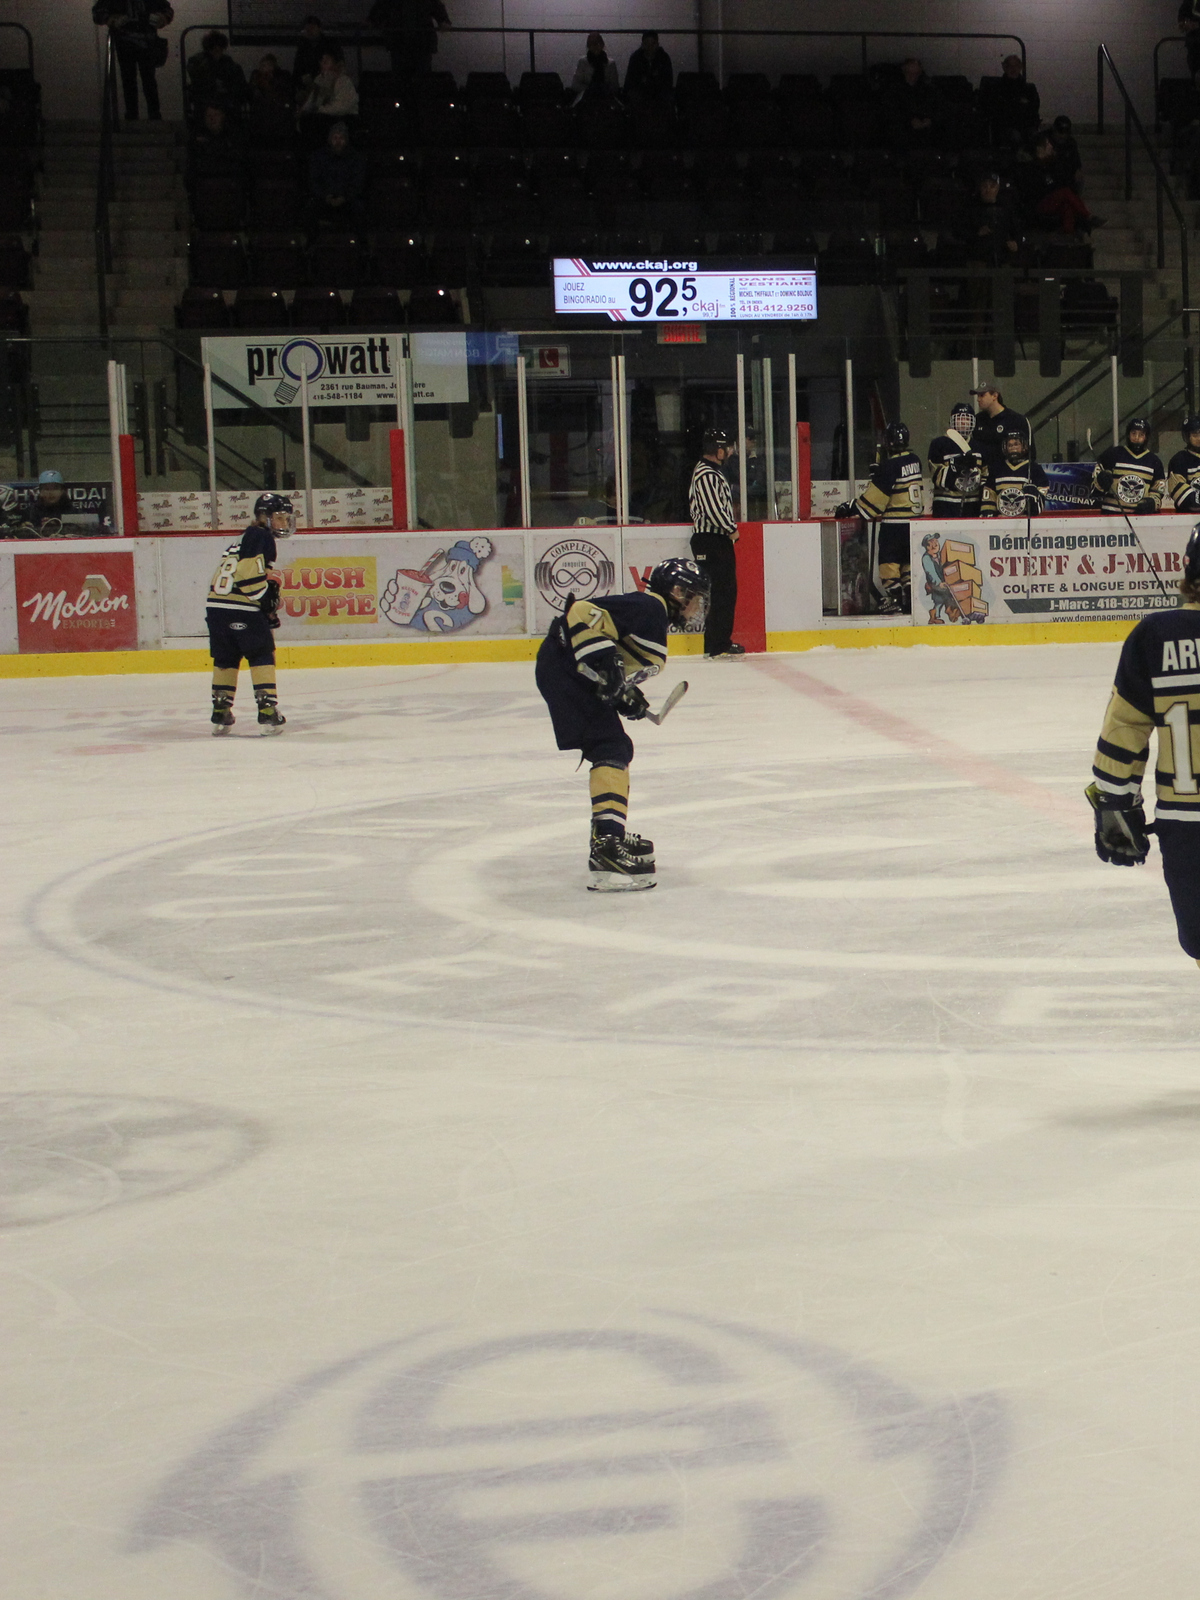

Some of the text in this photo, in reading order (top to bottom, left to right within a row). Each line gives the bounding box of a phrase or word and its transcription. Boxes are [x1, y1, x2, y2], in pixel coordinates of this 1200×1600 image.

[592, 260, 697, 271] www.ckaj.org
[563, 282, 585, 291] JOUEZ
[692, 299, 719, 318] ckaj
[739, 304, 814, 312] 418.412.9250
[1046, 494, 1096, 506] SAGUENAY
[989, 532, 1137, 550] Déménagement
[550, 542, 600, 559] COMPLEXE
[989, 555, 1070, 577] STEFF
[1077, 554, 1096, 575] &
[1003, 579, 1182, 594] COURTE & LONGUE DISTANC
[22, 590, 129, 629] Molson
[1050, 600, 1091, 611] J-Marc
